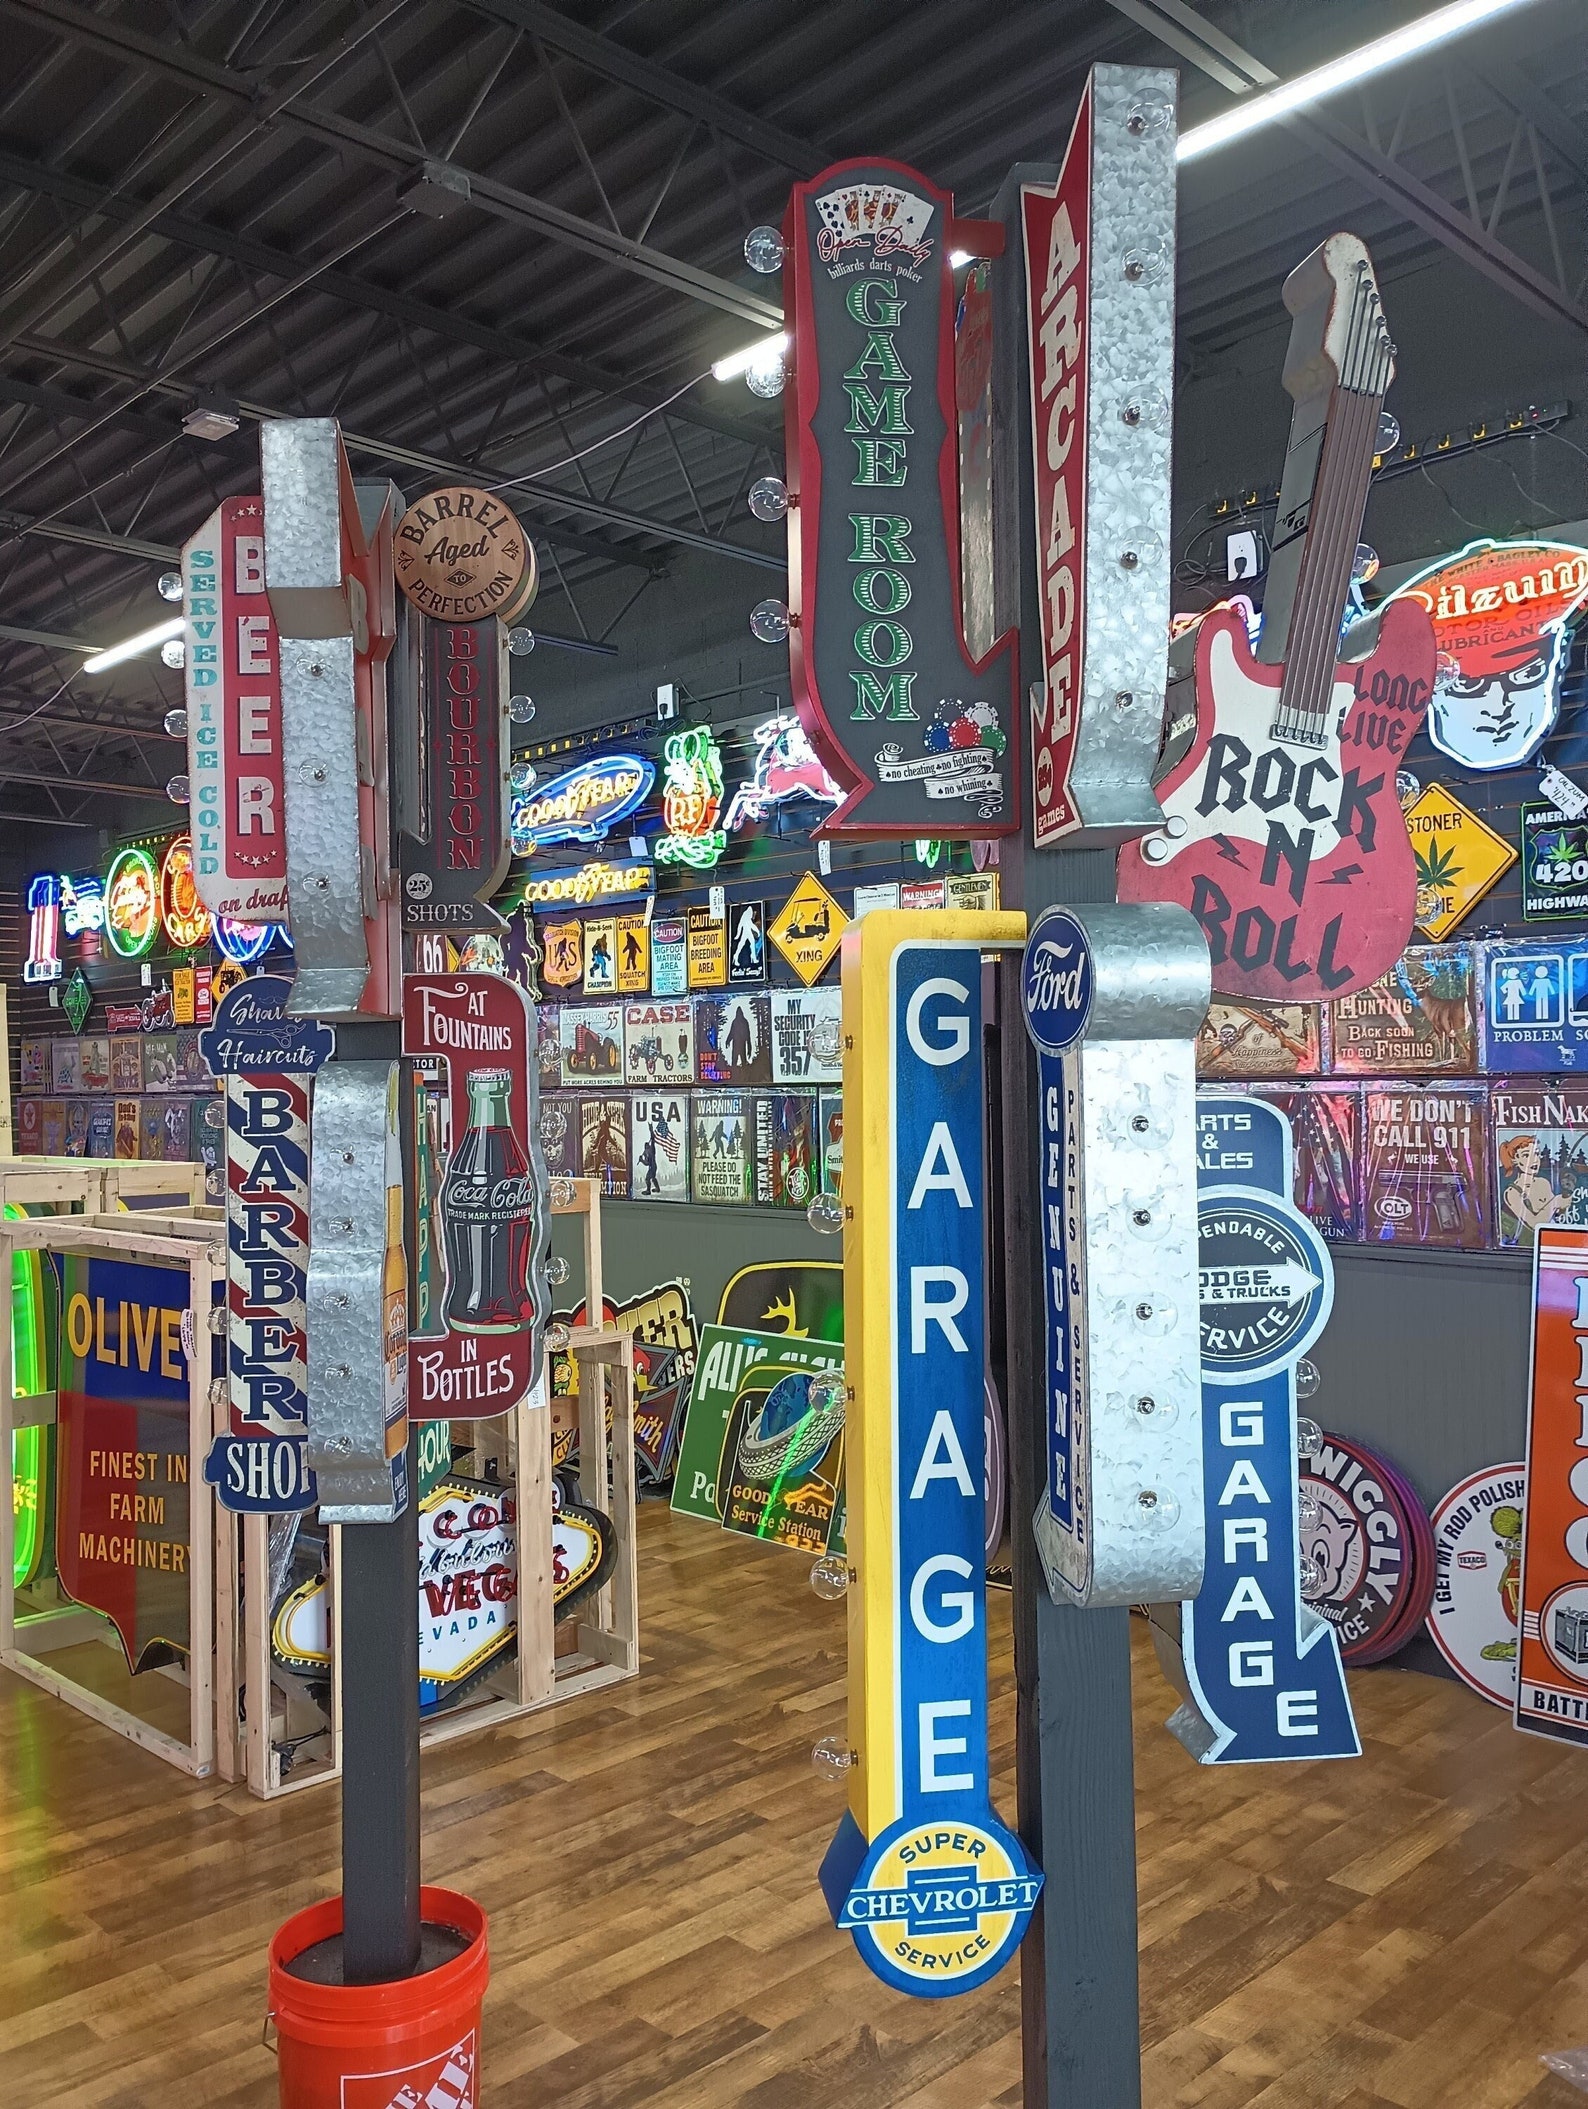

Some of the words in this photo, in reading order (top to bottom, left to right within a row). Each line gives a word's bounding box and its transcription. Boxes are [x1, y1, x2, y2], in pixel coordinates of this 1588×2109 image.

[817, 227, 871, 262] Open
[875, 226, 935, 268] Daily
[827, 258, 865, 280] billiards
[870, 257, 892, 271] darts
[896, 265, 923, 283] poker
[842, 277, 915, 486] GAME
[1040, 201, 1082, 745] ARCADE
[400, 493, 509, 545] BARREL
[424, 535, 490, 566] Aged
[454, 574, 467, 582] TO
[408, 570, 514, 615] PERFECTION
[190, 550, 217, 687] SERVED
[847, 513, 920, 721] ROOM
[235, 536, 276, 836] BEER
[1354, 665, 1429, 715] LONG
[197, 704, 217, 769] ICE
[1338, 706, 1407, 755] LIVE
[446, 629, 484, 870] BOURBON
[892, 770, 902, 779] no
[903, 763, 937, 778] cheating
[941, 761, 952, 771] no
[952, 753, 983, 769] fighting
[944, 786, 955, 795] no
[957, 777, 987, 792] whining
[1194, 732, 1386, 855] ROCK
[198, 786, 218, 875] COLD
[1038, 804, 1065, 835] games
[1406, 812, 1462, 834] STONER
[1260, 819, 1316, 908] N
[1535, 860, 1588, 883] 420
[218, 898, 242, 914] on
[246, 884, 289, 911] draf
[407, 904, 474, 922] SHOTS
[654, 927, 683, 938] CAUTION
[692, 933, 719, 946] BIGFOOT
[1190, 873, 1355, 991] ROLL
[654, 945, 684, 955] BIGFOOT
[657, 953, 682, 962] MATING
[691, 947, 722, 961] BREEDING
[620, 971, 646, 979] SQUATCH
[660, 961, 679, 970] AREA
[698, 962, 715, 974] AREA
[1028, 940, 1085, 1013] Ford
[230, 993, 302, 1025] Shav
[468, 991, 488, 1016] AT
[627, 1005, 690, 1024] CASE
[787, 999, 802, 1014] MY
[1337, 994, 1412, 1019] HUNTING
[606, 1011, 619, 1030] 55
[774, 1014, 816, 1031] SECURITY
[1349, 1026, 1381, 1041] BACK
[1386, 1027, 1415, 1038] SOON
[778, 1031, 799, 1046] CODE
[1494, 1030, 1564, 1042] PROBLEM
[217, 1038, 318, 1070] Haircuts
[779, 1046, 811, 1076] 357
[1341, 1048, 1356, 1059] TO
[1358, 1048, 1373, 1059] GO
[1375, 1040, 1433, 1061] FISHING
[653, 1074, 693, 1083] TRACTORS
[557, 1102, 572, 1113] YOU
[636, 1102, 681, 1122] USA
[697, 1099, 742, 1114] WARNING!
[1372, 1100, 1402, 1122] WE
[1410, 1100, 1473, 1122] DON'T
[1496, 1096, 1542, 1126] FISH
[757, 1100, 768, 1158] UNITED
[1202, 1134, 1219, 1150] &
[1374, 1125, 1427, 1148] CALL
[1433, 1126, 1470, 1148] 911
[702, 1161, 726, 1172] PLEASE
[727, 1162, 737, 1172] DO
[1067, 1089, 1077, 1242] PARTS
[1197, 1152, 1253, 1170] ALES
[1404, 1154, 1419, 1164] WE
[1422, 1154, 1439, 1164] USE
[698, 1174, 711, 1184] NOT
[712, 1174, 728, 1184] FEED
[729, 1174, 741, 1185] THE
[701, 1186, 739, 1197] SASQUATCH
[757, 1159, 769, 1201] STAY
[468, 1212, 491, 1220] MARK
[239, 1088, 303, 1423] BARBER
[1069, 1264, 1080, 1296] &
[1200, 1269, 1271, 1288] ODGE
[1212, 1289, 1224, 1299] &
[1227, 1286, 1291, 1299] TRUCKS
[1046, 1086, 1068, 1502] GENUINE
[67, 1292, 190, 1380] OLIVE
[460, 1338, 477, 1363] IN
[417, 1351, 514, 1403] BOTTLES
[905, 977, 975, 1793] GARAGE
[1073, 1325, 1085, 1545] SERVICE
[90, 1450, 158, 1482] FINEST
[167, 1453, 188, 1483] IN
[110, 1494, 165, 1525] FARM
[731, 1505, 775, 1529] Service
[778, 1518, 821, 1541] Station
[1443, 1505, 1473, 1540] ROD
[1310, 1445, 1400, 1606] WIGGLY
[1436, 1539, 1455, 1566] MY
[1459, 1556, 1486, 1565] TEXACO
[1218, 1401, 1319, 1737] GARAGE
[1435, 1572, 1451, 1603] GET
[1534, 1690, 1588, 1716] BATT
[899, 1833, 987, 1865] SUPER
[847, 1880, 1039, 1919] CHEVROLET
[895, 1934, 991, 1970] SERVICE
